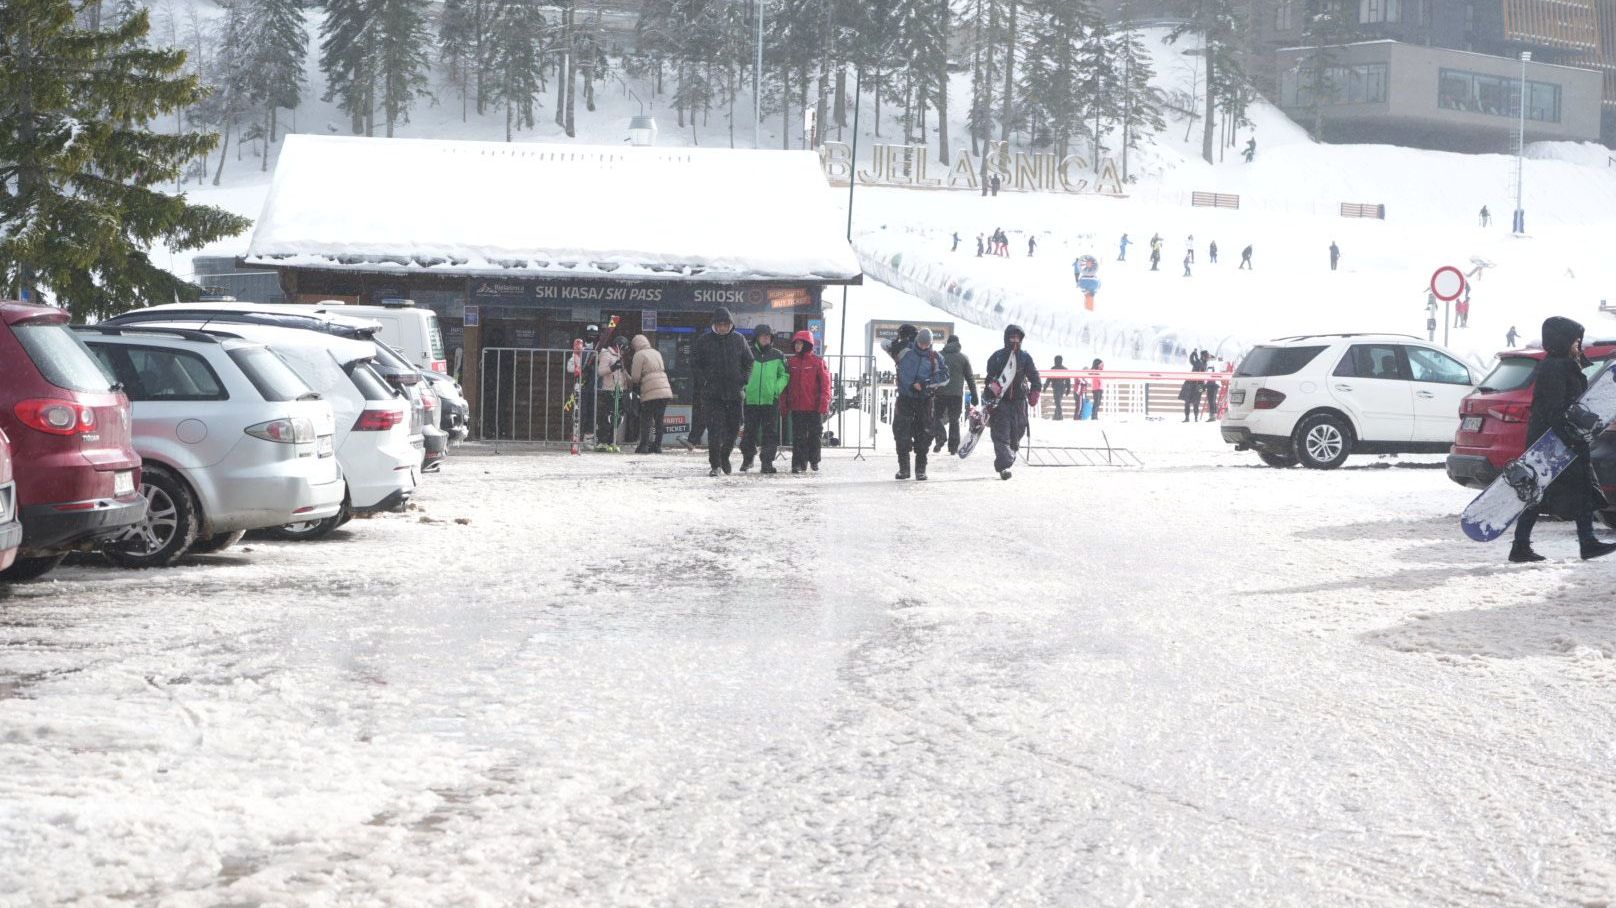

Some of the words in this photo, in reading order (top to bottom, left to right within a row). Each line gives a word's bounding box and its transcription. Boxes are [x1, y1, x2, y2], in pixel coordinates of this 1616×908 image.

[824, 139, 1123, 194] BJELAŠNICA
[535, 286, 558, 298] SKI
[629, 288, 663, 301] PASS
[694, 290, 744, 303] SKIOSK
